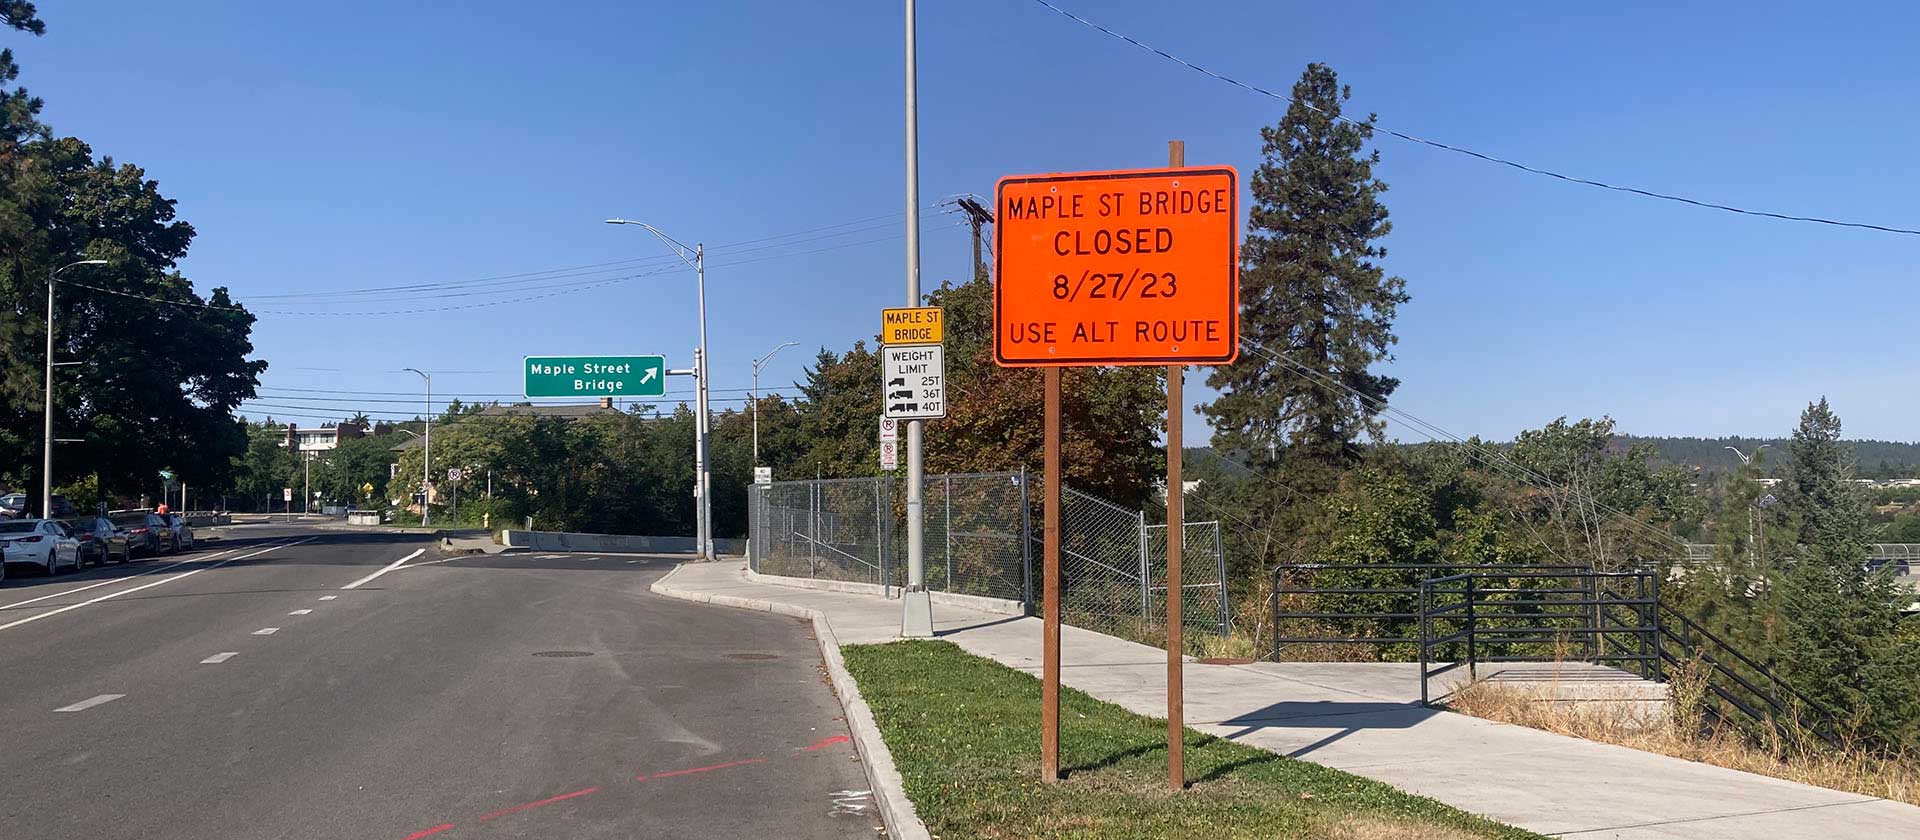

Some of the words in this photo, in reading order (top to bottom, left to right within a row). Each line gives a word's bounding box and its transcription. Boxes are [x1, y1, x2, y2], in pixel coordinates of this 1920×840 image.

[1008, 194, 1084, 220] MAPLE
[1098, 192, 1125, 217] ST
[1139, 189, 1227, 215] BRIDGE
[1054, 228, 1173, 256] CLOSED
[1052, 268, 1177, 302] 8/27/23
[886, 313, 922, 324] MAPLE
[926, 311, 939, 323] ST
[894, 328, 932, 340] BRIDGE
[1010, 322, 1057, 344] USE
[1072, 321, 1119, 343] ALT
[1135, 320, 1220, 343] ROUTE
[892, 351, 934, 361] WEIGHT
[531, 364, 575, 376] Maple
[583, 363, 631, 374] Street
[898, 364, 928, 374] LIMIT
[574, 379, 624, 392] Bridge
[921, 376, 940, 386] 25T
[922, 389, 941, 399] 36T
[922, 401, 941, 412] 40T
